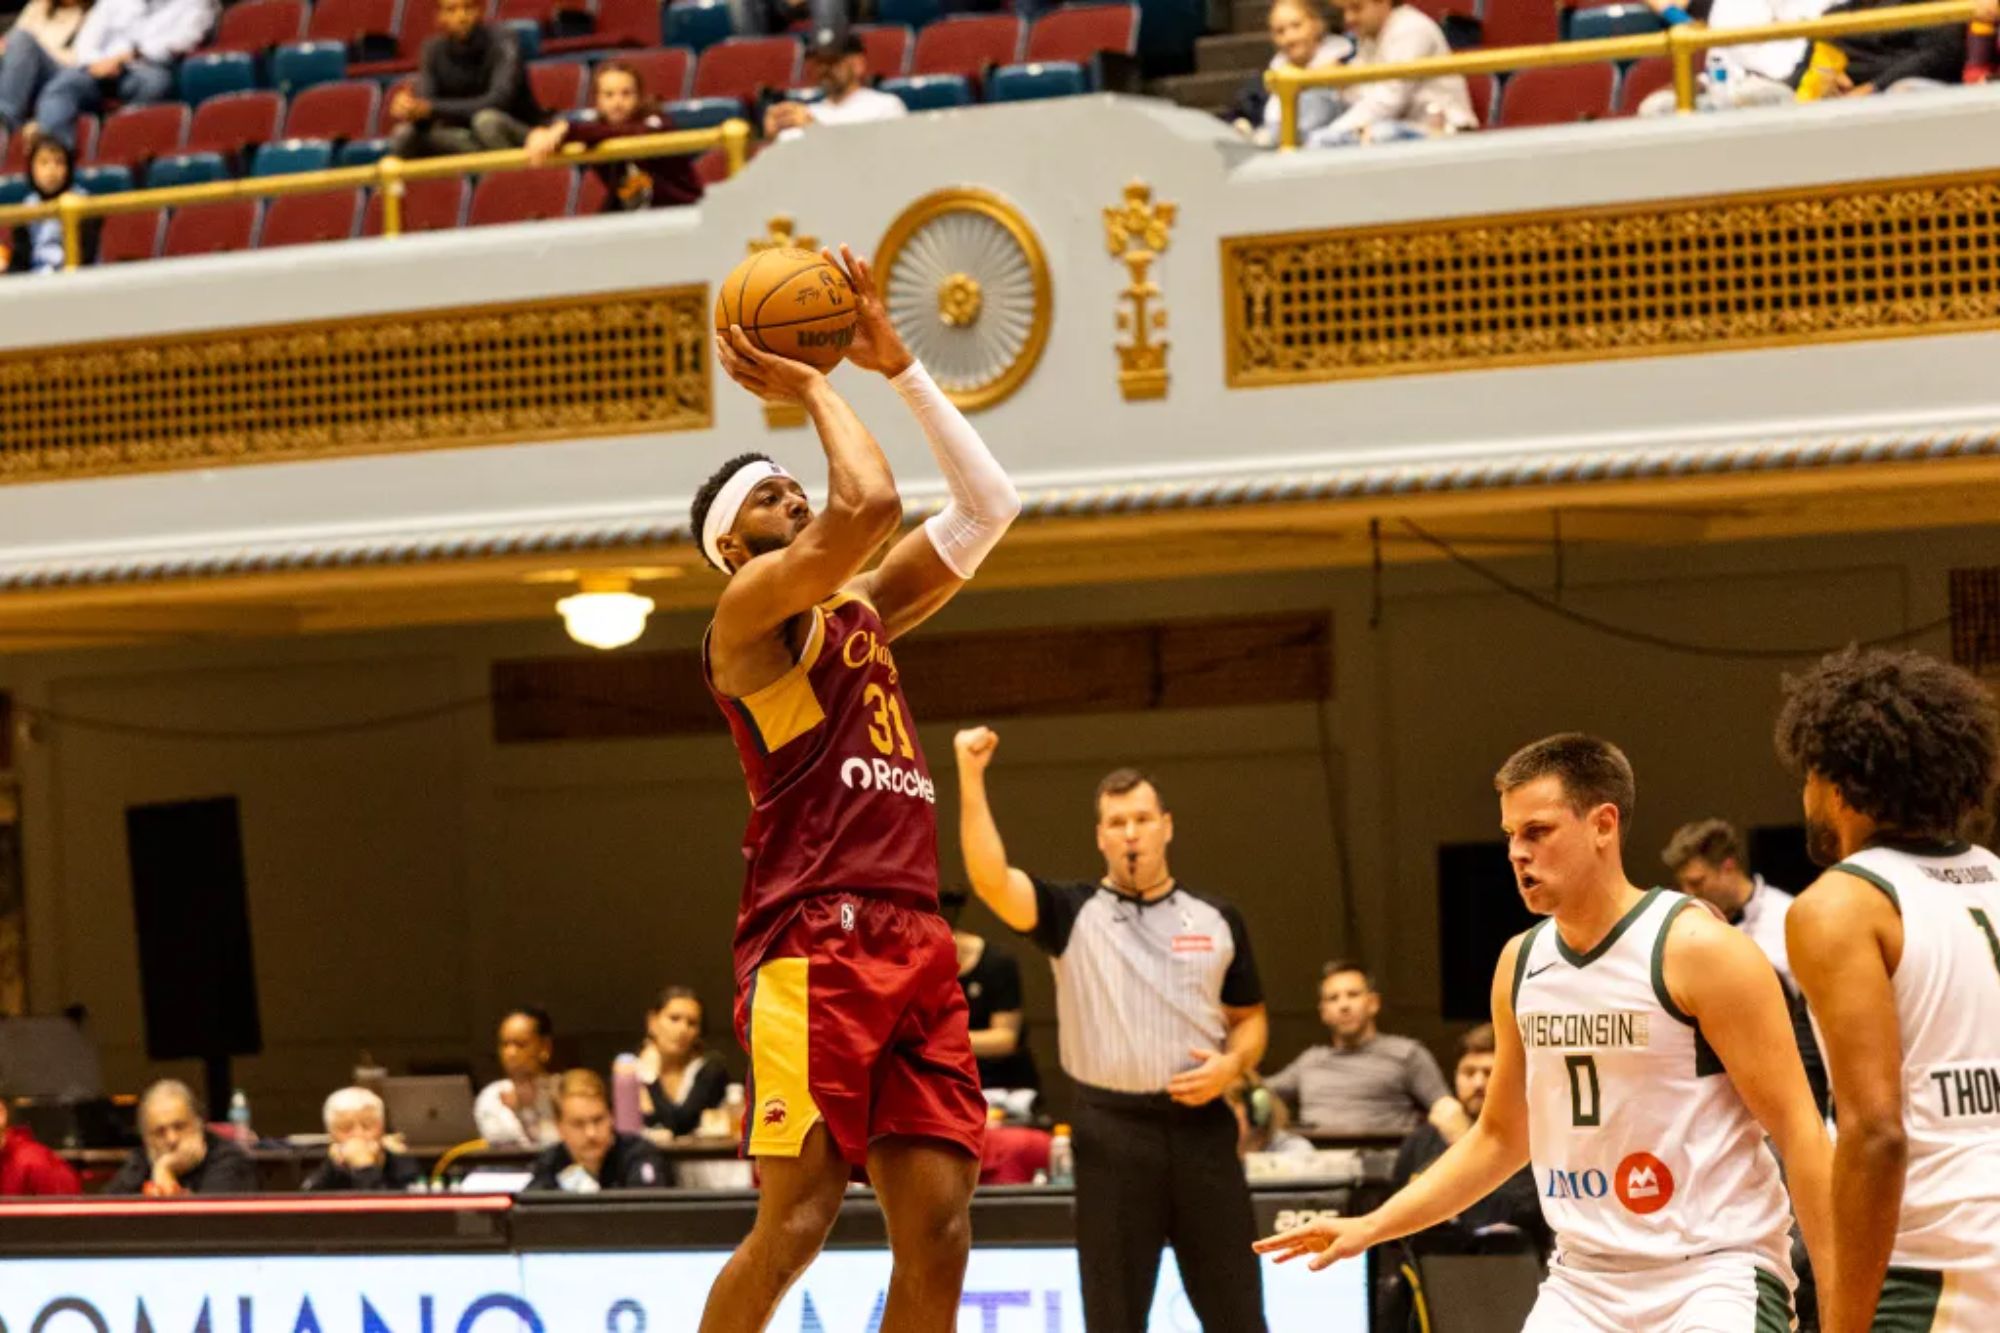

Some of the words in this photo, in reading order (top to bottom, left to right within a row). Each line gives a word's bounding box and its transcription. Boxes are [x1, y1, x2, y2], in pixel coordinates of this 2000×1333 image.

[864, 683, 915, 761] 31
[872, 757, 936, 805] Rocke
[1565, 1055, 1600, 1126] 0
